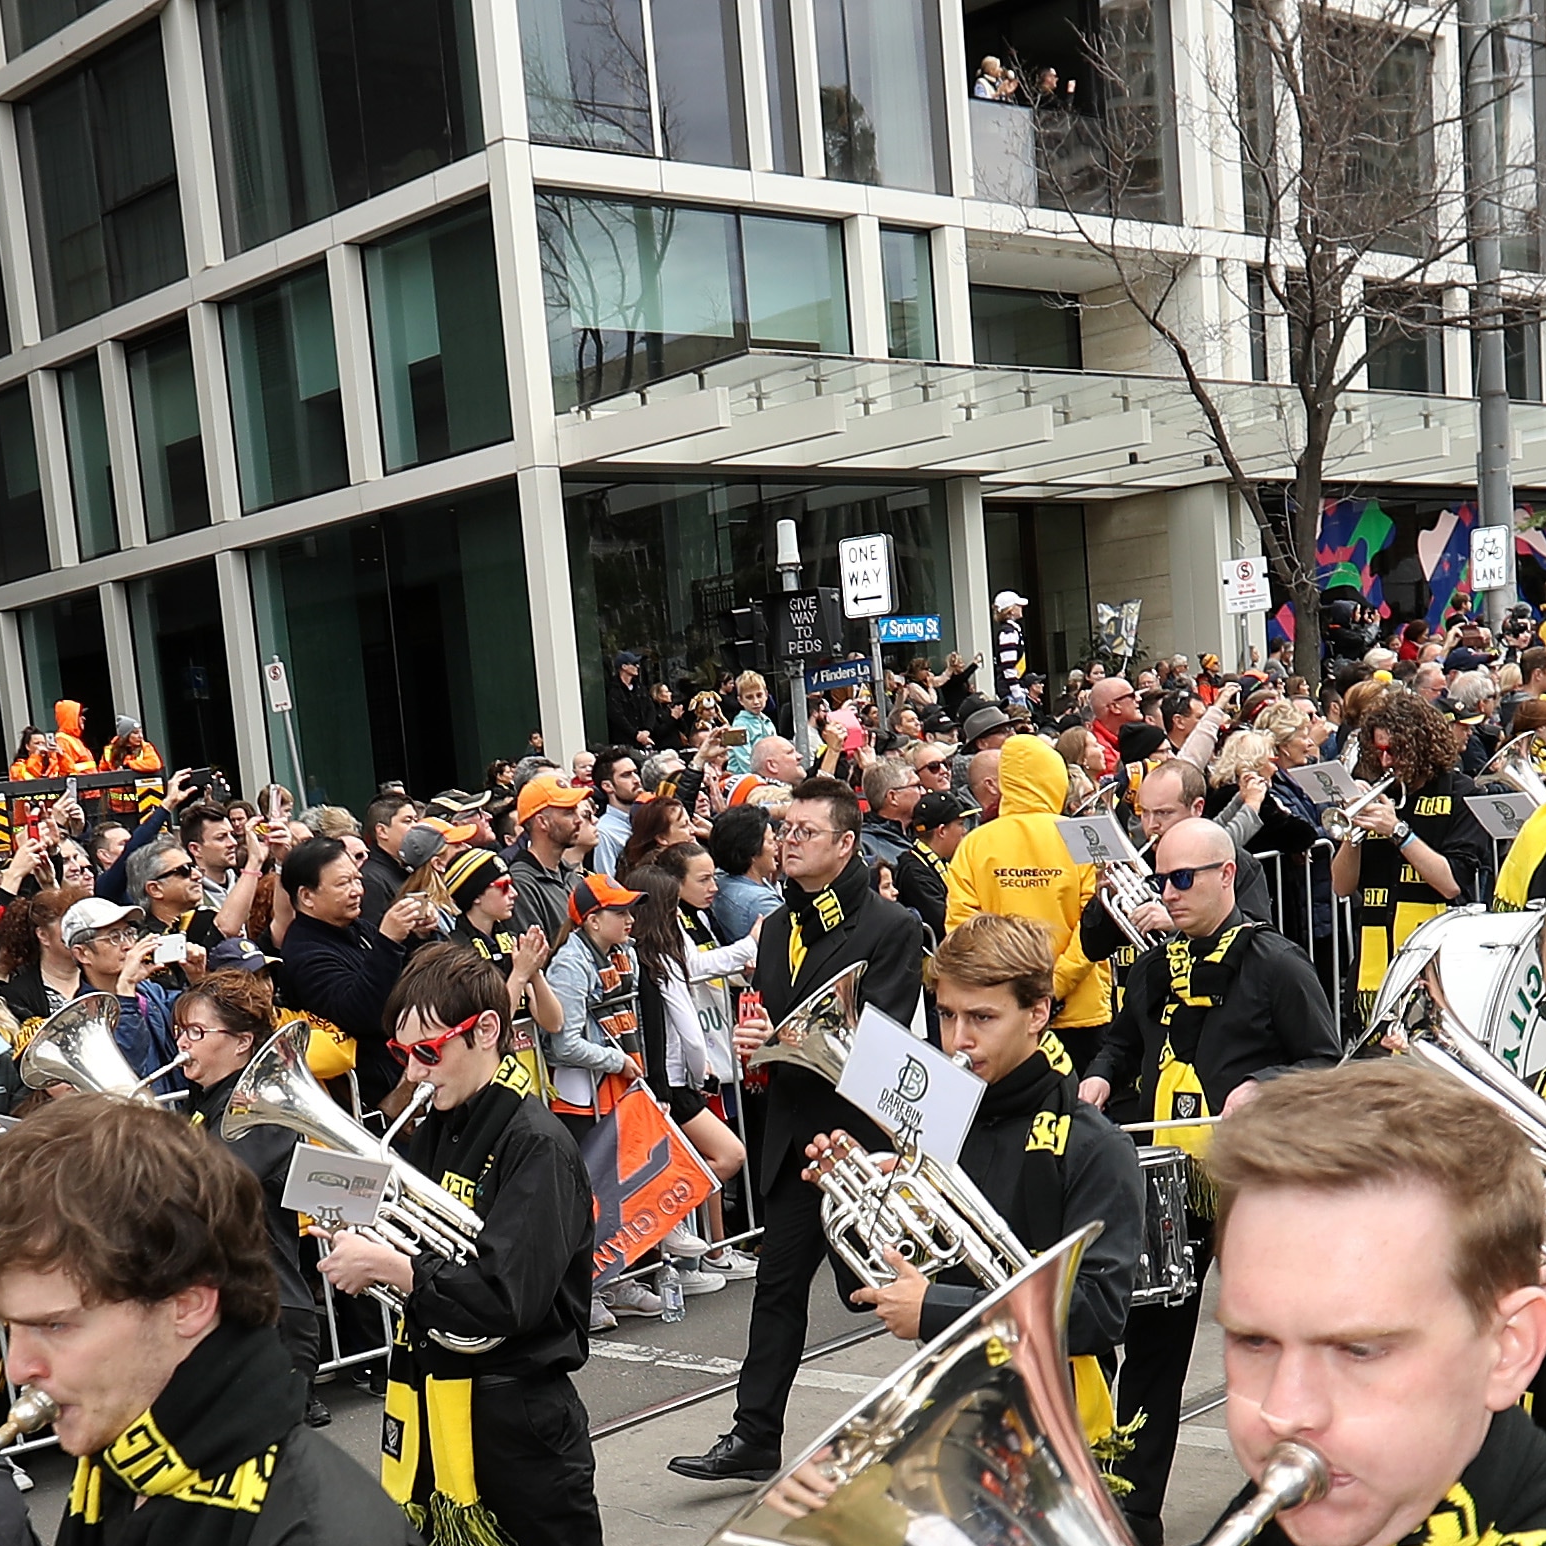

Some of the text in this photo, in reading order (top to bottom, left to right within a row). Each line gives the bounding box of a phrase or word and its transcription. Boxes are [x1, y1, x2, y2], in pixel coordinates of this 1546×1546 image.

[848, 545, 878, 563] ONE
[848, 568, 882, 587] WAY
[1475, 566, 1503, 581] LANE
[789, 596, 818, 611] GIVE
[790, 610, 818, 625] WAY
[795, 625, 813, 639] TO
[889, 618, 939, 640] Spring St
[788, 639, 823, 654] PEDS
[819, 666, 856, 683] Flinders
[857, 663, 871, 676] La
[993, 868, 1063, 878] SECUREcorp
[1000, 878, 1051, 888] SECURITY
[880, 1087, 924, 1126] DAREBIN
[593, 1178, 694, 1272] GO GIAN
